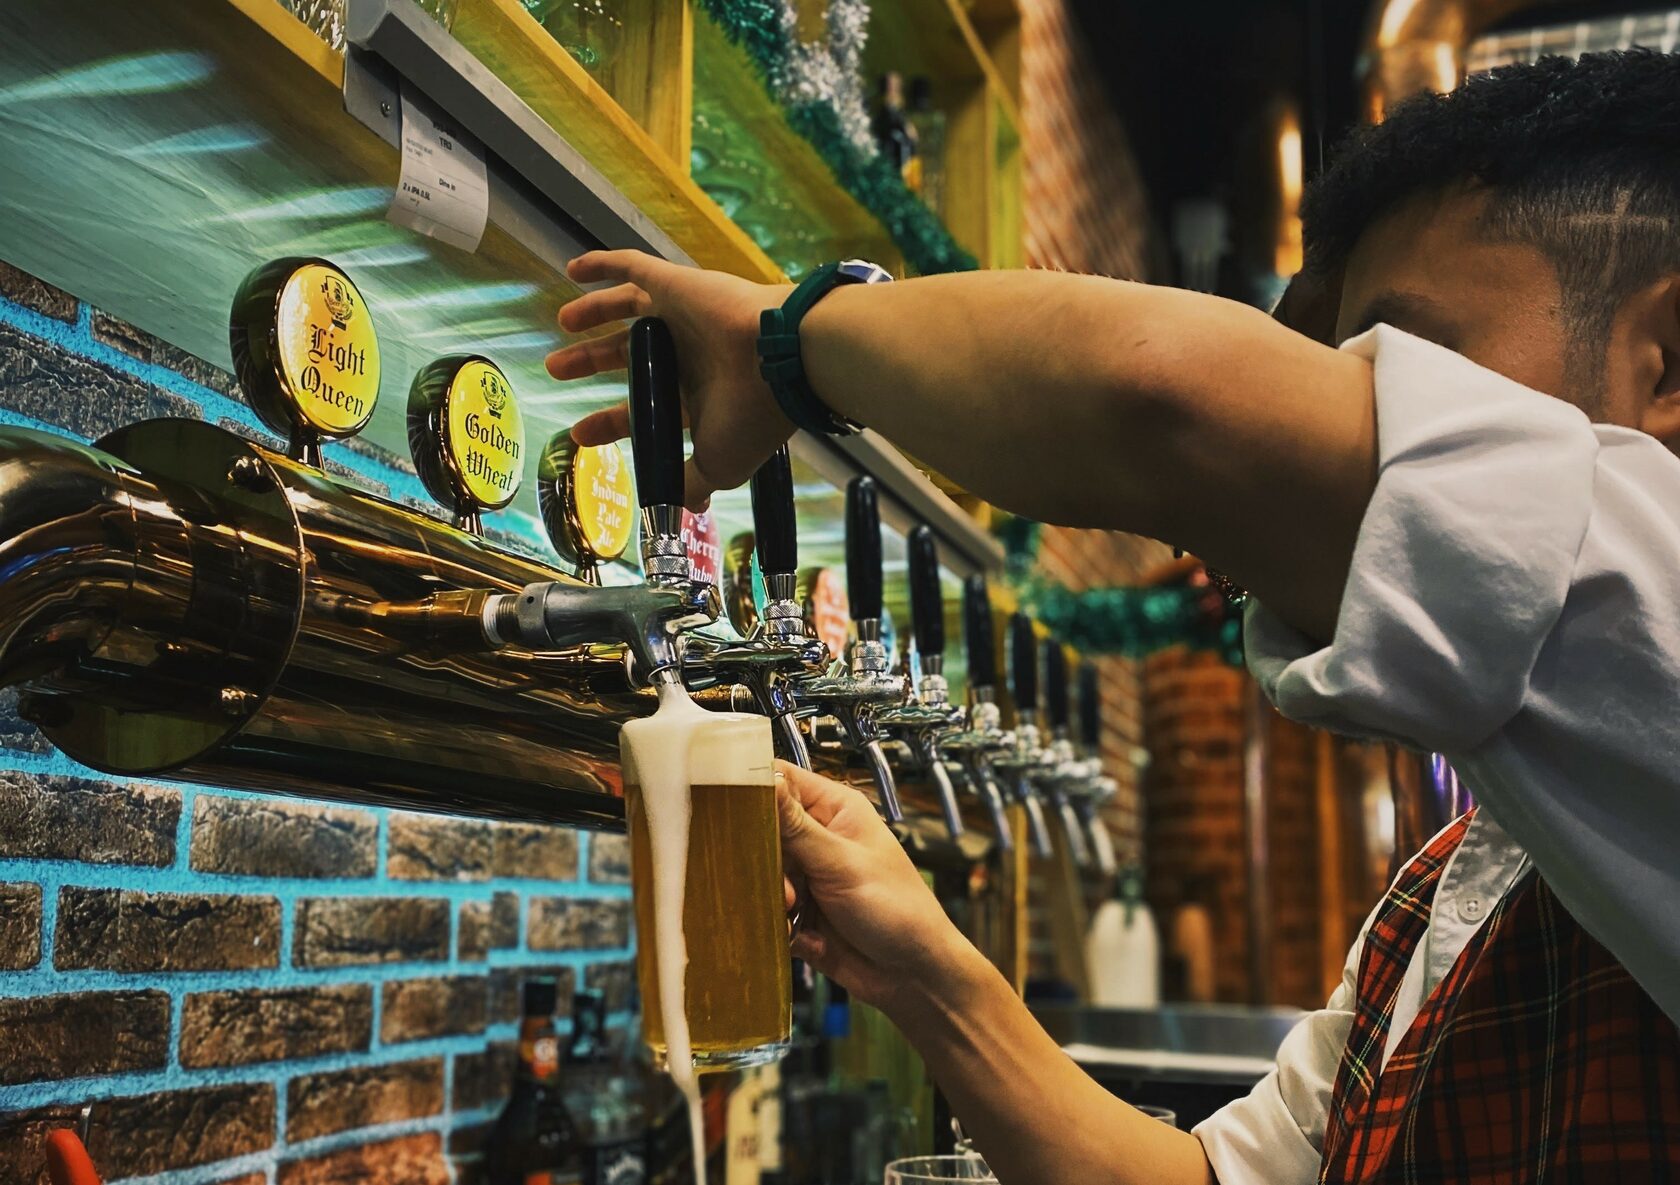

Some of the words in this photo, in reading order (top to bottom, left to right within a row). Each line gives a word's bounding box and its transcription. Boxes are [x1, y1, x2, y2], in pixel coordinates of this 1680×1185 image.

[411, 186, 419, 195] IPA
[308, 324, 365, 376] Light
[301, 365, 364, 418] Queen
[465, 413, 520, 460] Golden
[466, 445, 514, 491] Wheat
[591, 475, 628, 508] Indian
[596, 502, 621, 529] Pale
